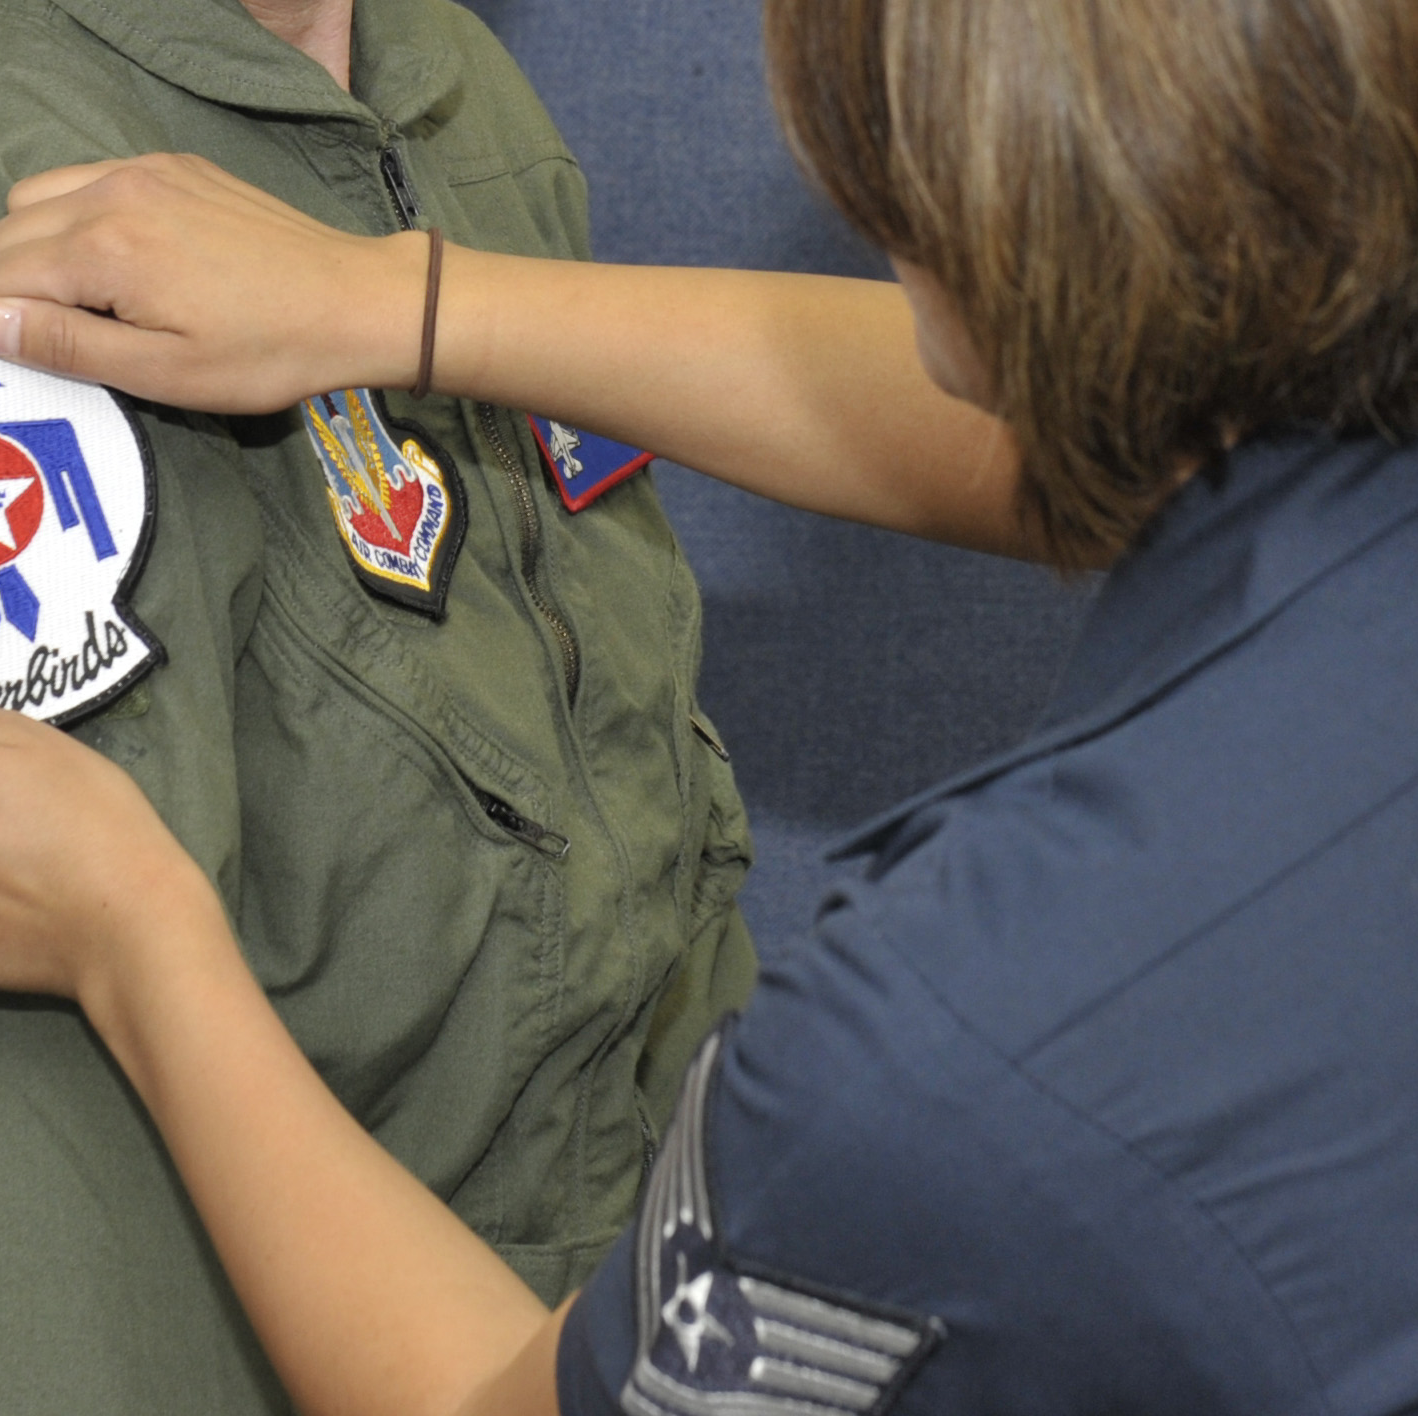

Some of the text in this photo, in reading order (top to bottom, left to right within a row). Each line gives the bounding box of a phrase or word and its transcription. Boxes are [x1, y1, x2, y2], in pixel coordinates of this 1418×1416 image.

[351, 483, 444, 580] AIR COMBAT COMMAND
